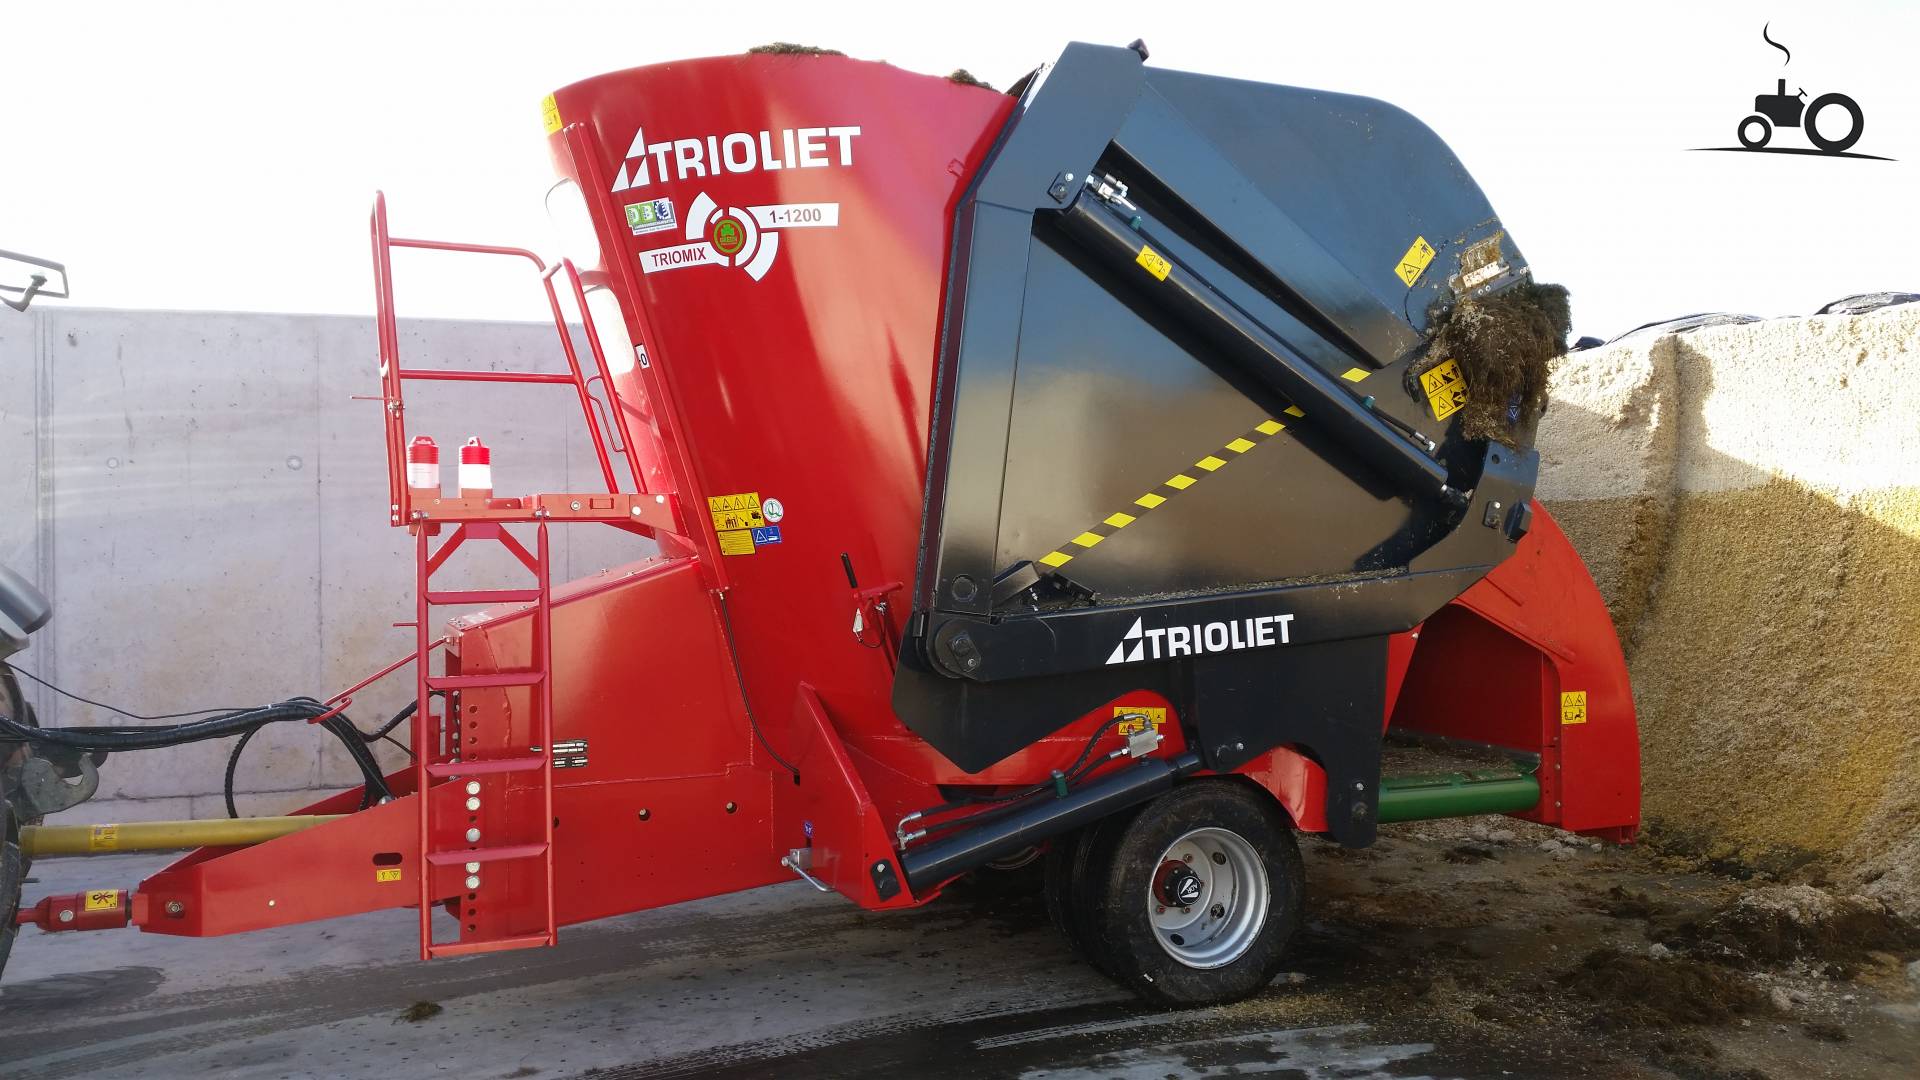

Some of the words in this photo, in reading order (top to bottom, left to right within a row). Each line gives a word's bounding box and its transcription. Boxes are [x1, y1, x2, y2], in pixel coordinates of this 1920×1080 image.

[648, 126, 861, 184] TRIOLIET
[769, 208, 822, 224] 1-1200
[651, 246, 707, 268] TRIOMIX
[1145, 613, 1295, 660] TRIOLIET
